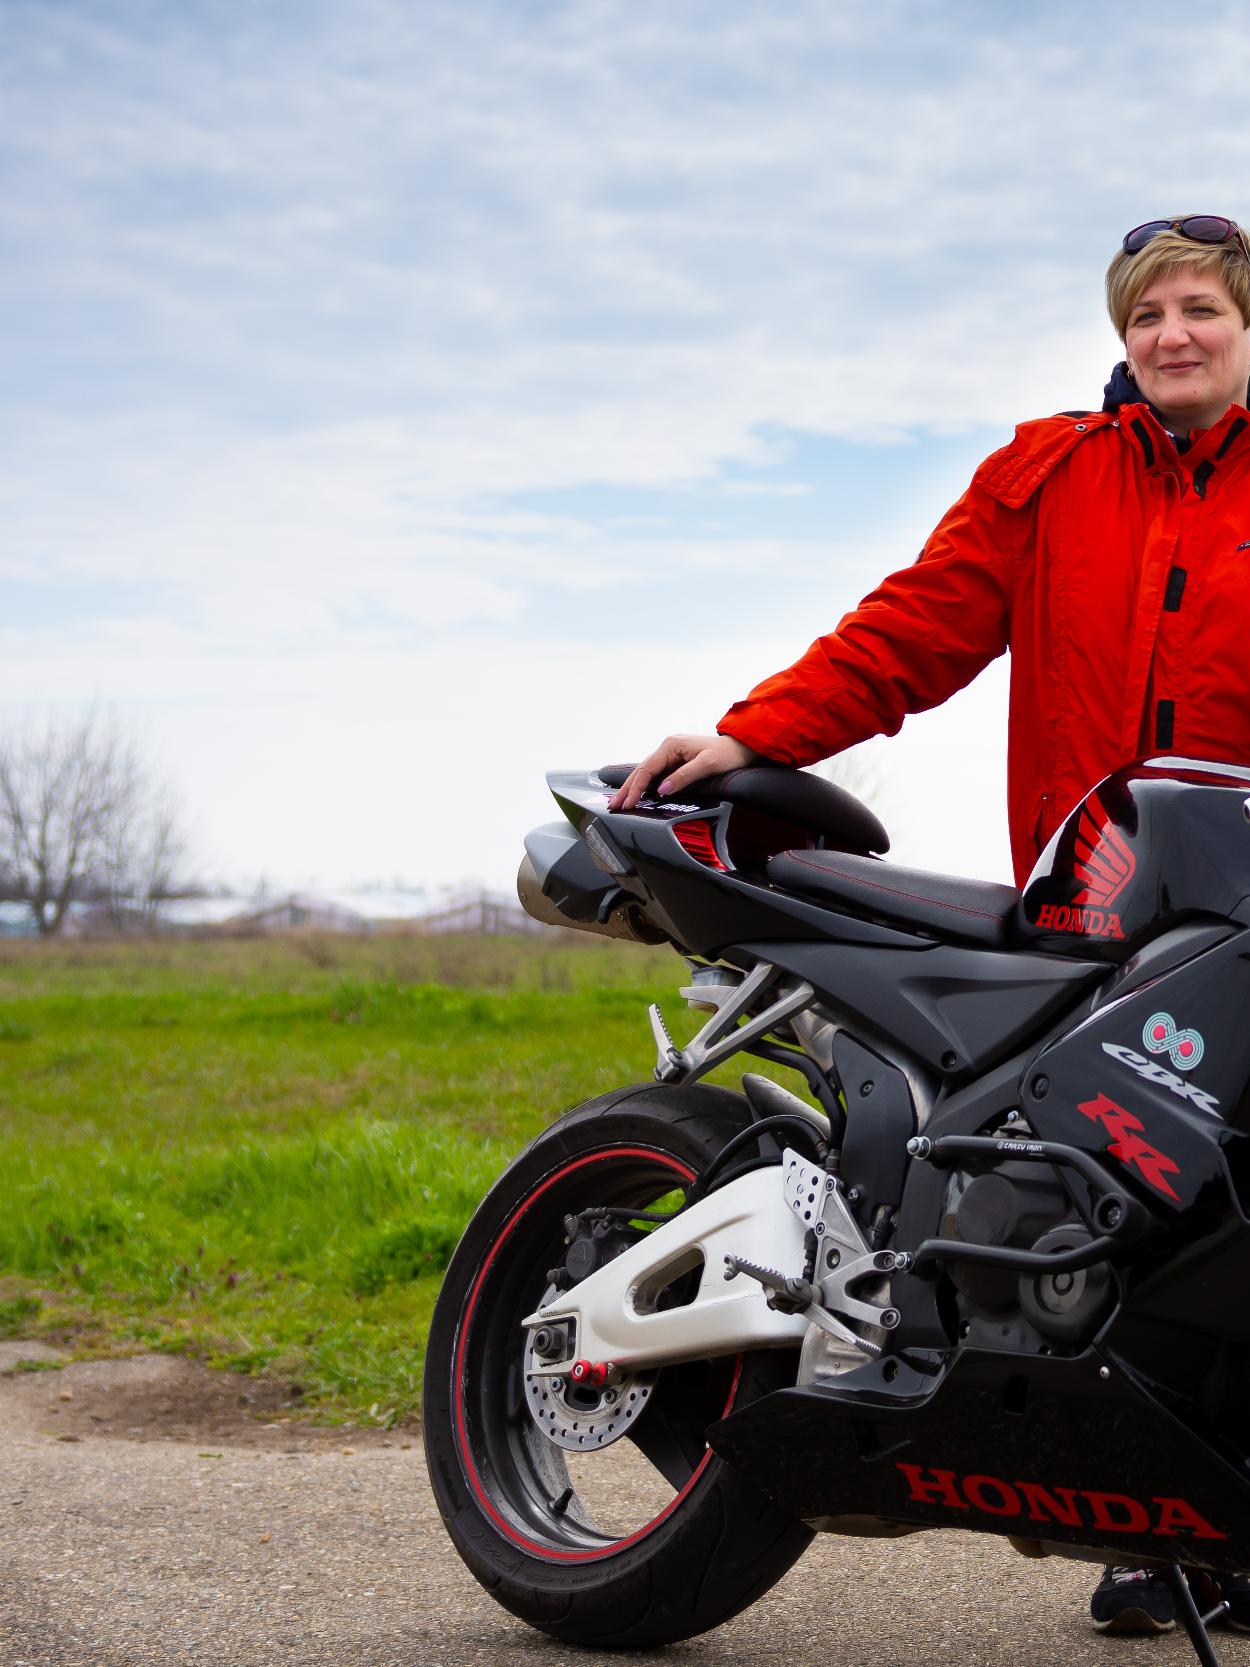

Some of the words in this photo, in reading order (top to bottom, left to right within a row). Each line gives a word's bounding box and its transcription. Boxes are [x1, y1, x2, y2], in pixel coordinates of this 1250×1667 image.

[1034, 905, 1127, 939] HONDA
[1101, 1041, 1224, 1121] CBR
[1077, 1091, 1182, 1202] RR
[896, 1462, 1227, 1539] HONDA
